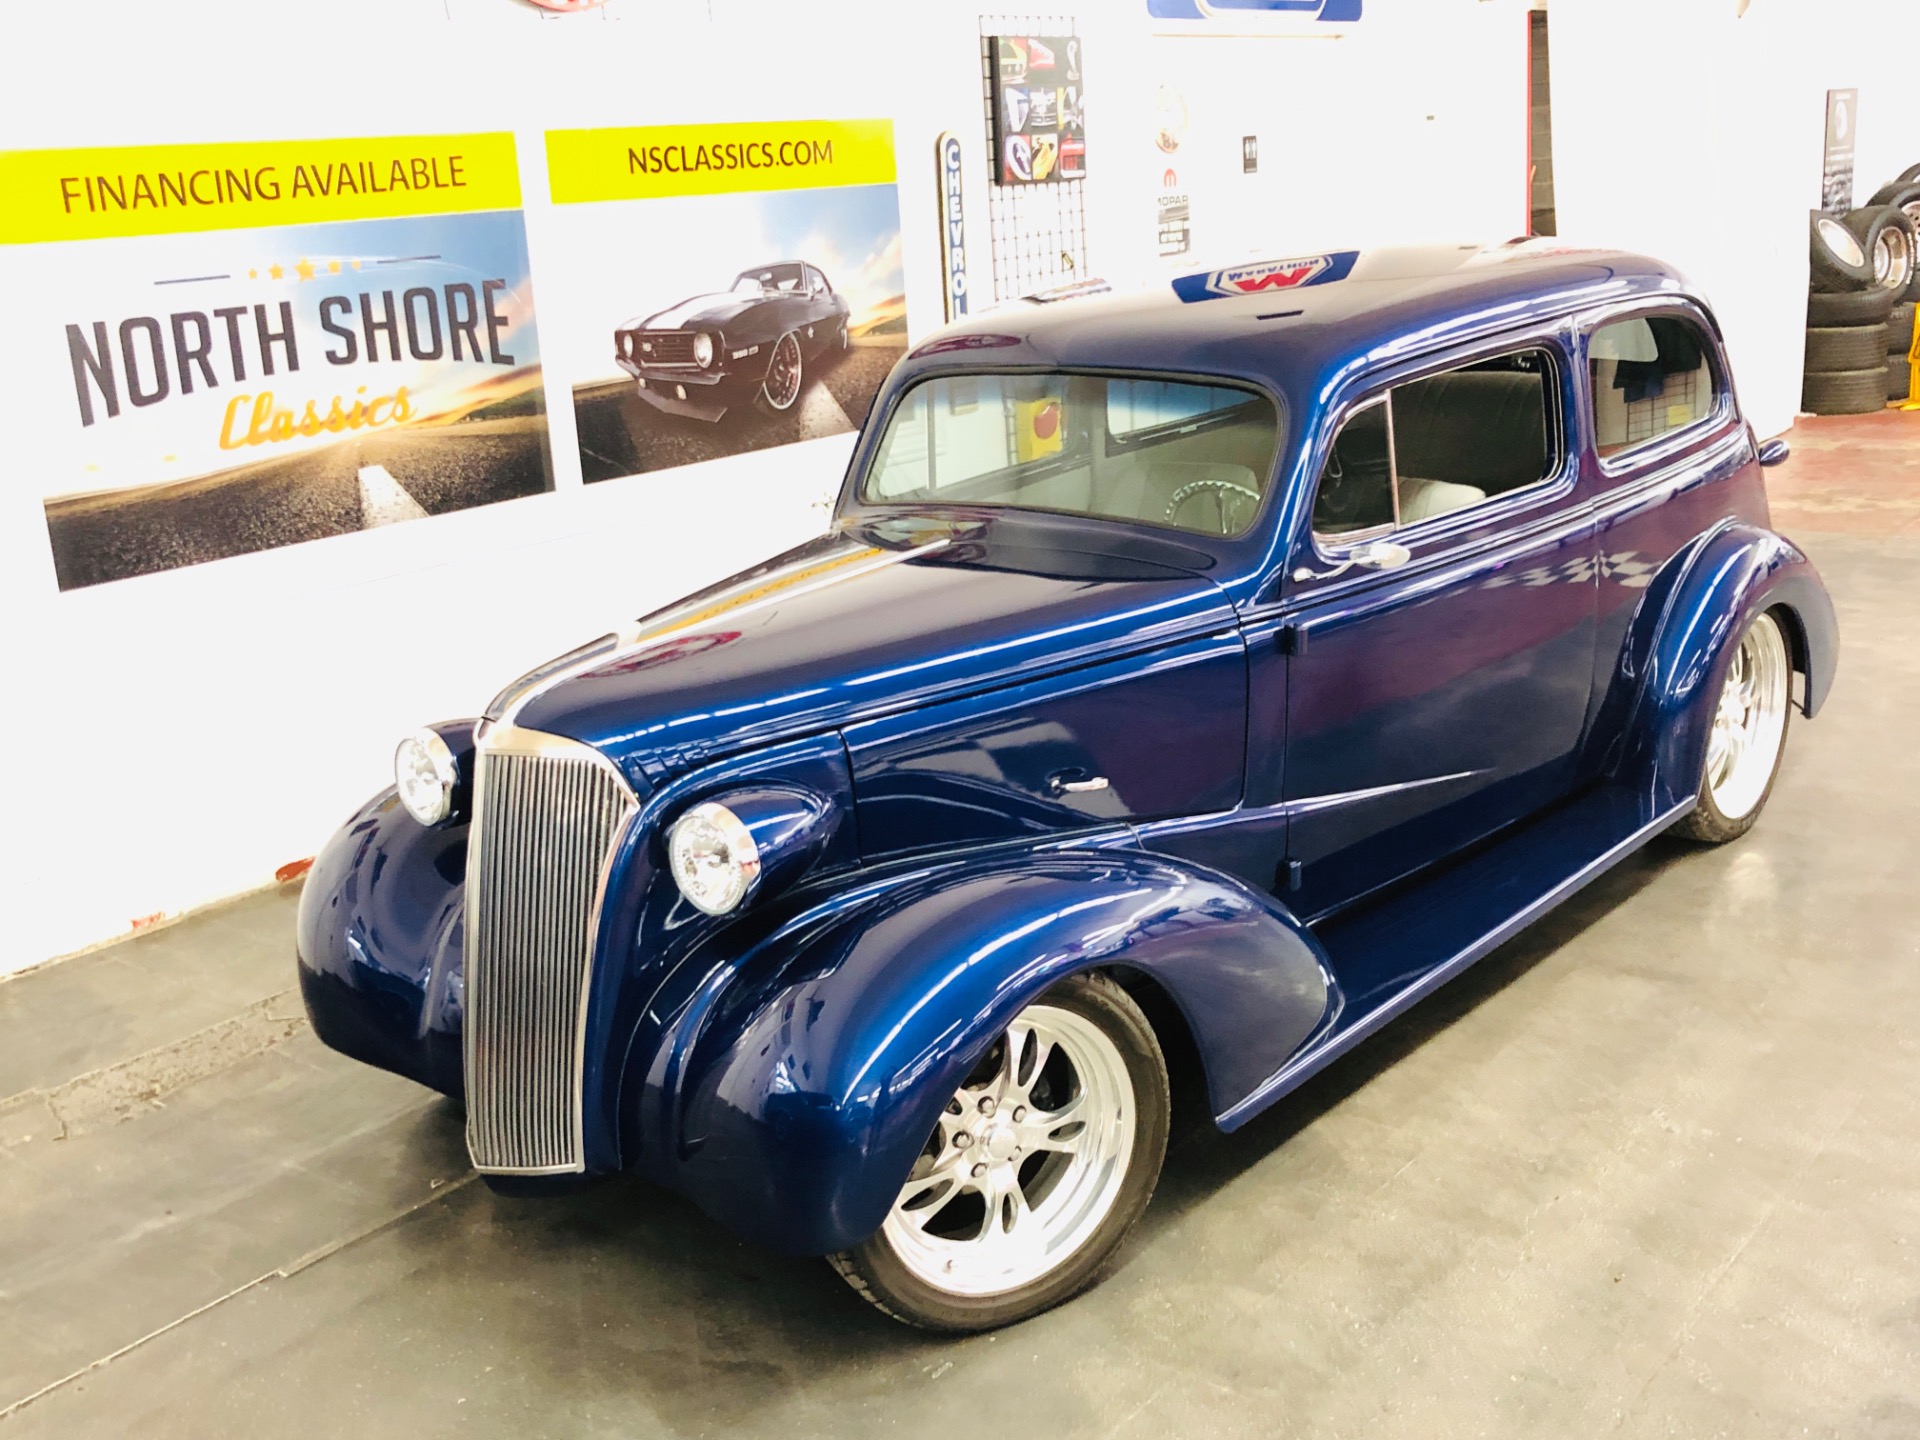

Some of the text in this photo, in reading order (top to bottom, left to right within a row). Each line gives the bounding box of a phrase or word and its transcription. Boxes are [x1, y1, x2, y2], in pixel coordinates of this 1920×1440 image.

[60, 155, 467, 214] FINANCING AVAILABLE
[628, 140, 833, 174] NSCLASSICS.COM
[65, 278, 515, 428] NORTH SHORE
[219, 385, 417, 451] Classics
